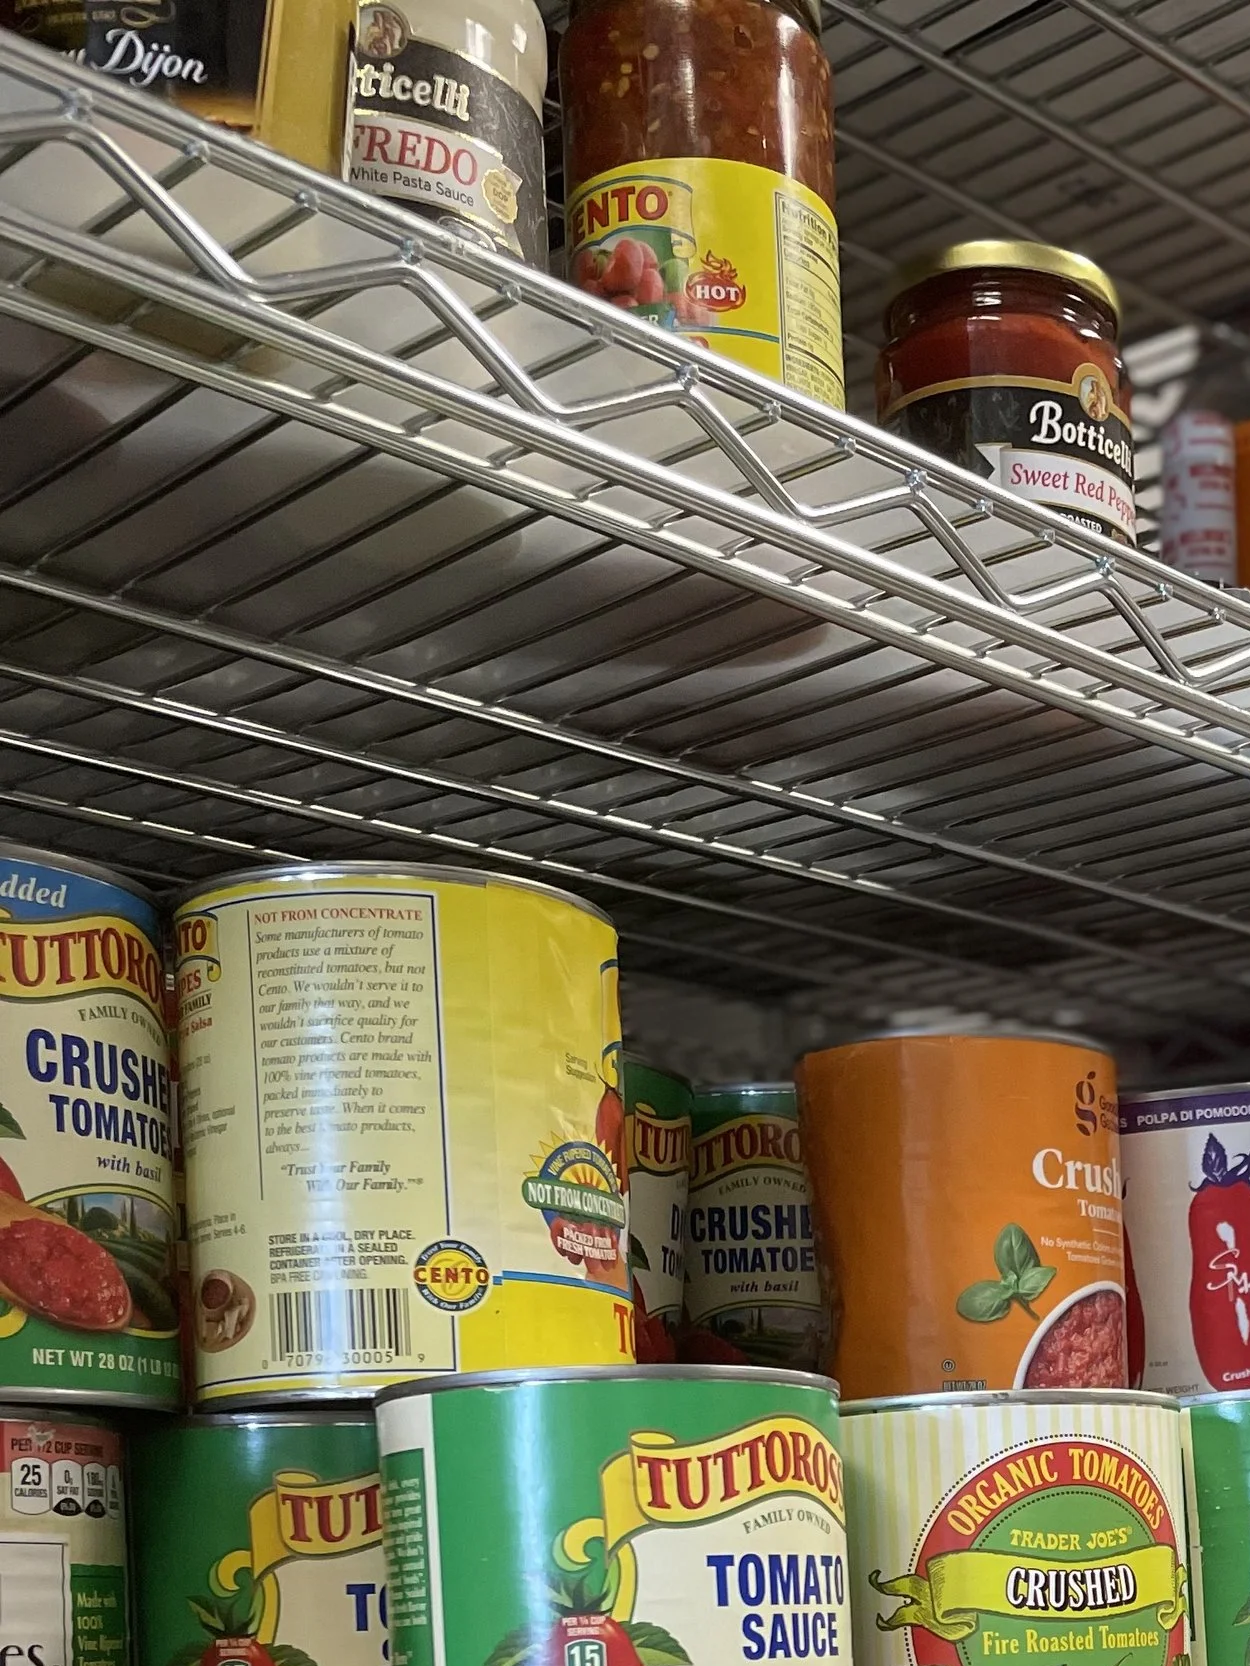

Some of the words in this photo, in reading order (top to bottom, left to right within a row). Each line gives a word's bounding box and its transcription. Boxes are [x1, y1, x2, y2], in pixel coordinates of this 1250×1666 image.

[91, 28, 208, 88] Dijon
[393, 171, 432, 192] Pasta
[436, 181, 474, 207] Sauce
[696, 284, 738, 302] HOT
[1011, 463, 1069, 490] Sweet
[1075, 473, 1104, 502] Red
[254, 911, 277, 924] NOT
[281, 909, 317, 922] FROM
[320, 908, 422, 922] CONCENTRATE
[255, 930, 282, 943] Some
[284, 927, 364, 942] manufacturers
[368, 926, 381, 940] of
[383, 927, 423, 941] tomato
[1137, 1112, 1178, 1126] POLPA
[1180, 1110, 1193, 1122] DI
[97, 1154, 131, 1176] with
[135, 1162, 161, 1182] basil
[350, 1161, 390, 1175] Family
[528, 1182, 552, 1204] NOT
[555, 1186, 581, 1210] FROM
[358, 1243, 398, 1254] SEALED
[270, 1257, 320, 1270] CONTAINER
[359, 1254, 408, 1266] OPENING.
[413, 1267, 489, 1284] CENTO
[343, 1352, 393, 1365] 30005
[20, 1464, 41, 1486] 25
[14, 1488, 47, 1498] CALORIES
[946, 1448, 1058, 1537] ORGANIC
[1068, 1447, 1164, 1531] TOMATOES
[1010, 1528, 1080, 1551] TRADER
[706, 1554, 844, 1607] TOMATO
[1005, 1562, 1137, 1613] CRUSHED
[742, 1612, 839, 1660] SAUCE
[982, 1629, 1020, 1656] Fire
[1026, 1627, 1094, 1655] Roasted
[1099, 1624, 1159, 1651] Tomatoes
